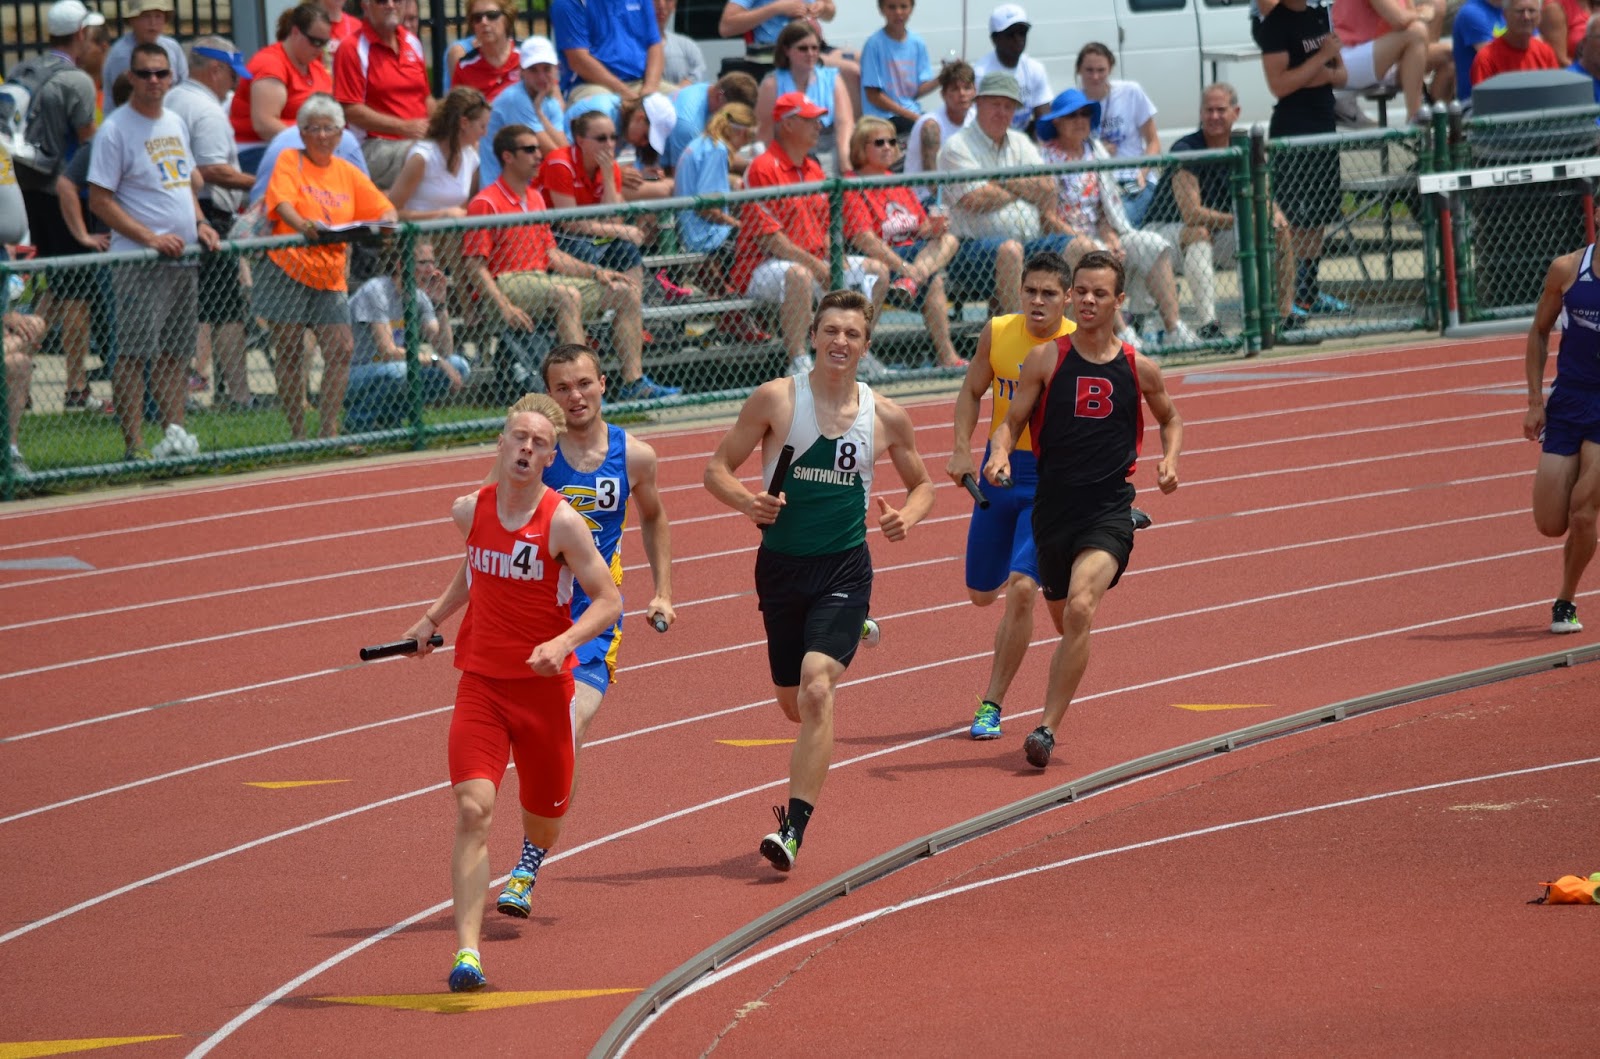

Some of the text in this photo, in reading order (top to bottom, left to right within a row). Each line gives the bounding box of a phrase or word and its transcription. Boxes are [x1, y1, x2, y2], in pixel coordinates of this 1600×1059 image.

[1491, 169, 1533, 184] UCS
[1074, 376, 1113, 419] B
[838, 442, 857, 470] 8
[793, 466, 856, 486] SMITHVILLE
[598, 480, 615, 509] 3
[468, 545, 544, 581] EASTWD
[513, 545, 532, 575] 4
